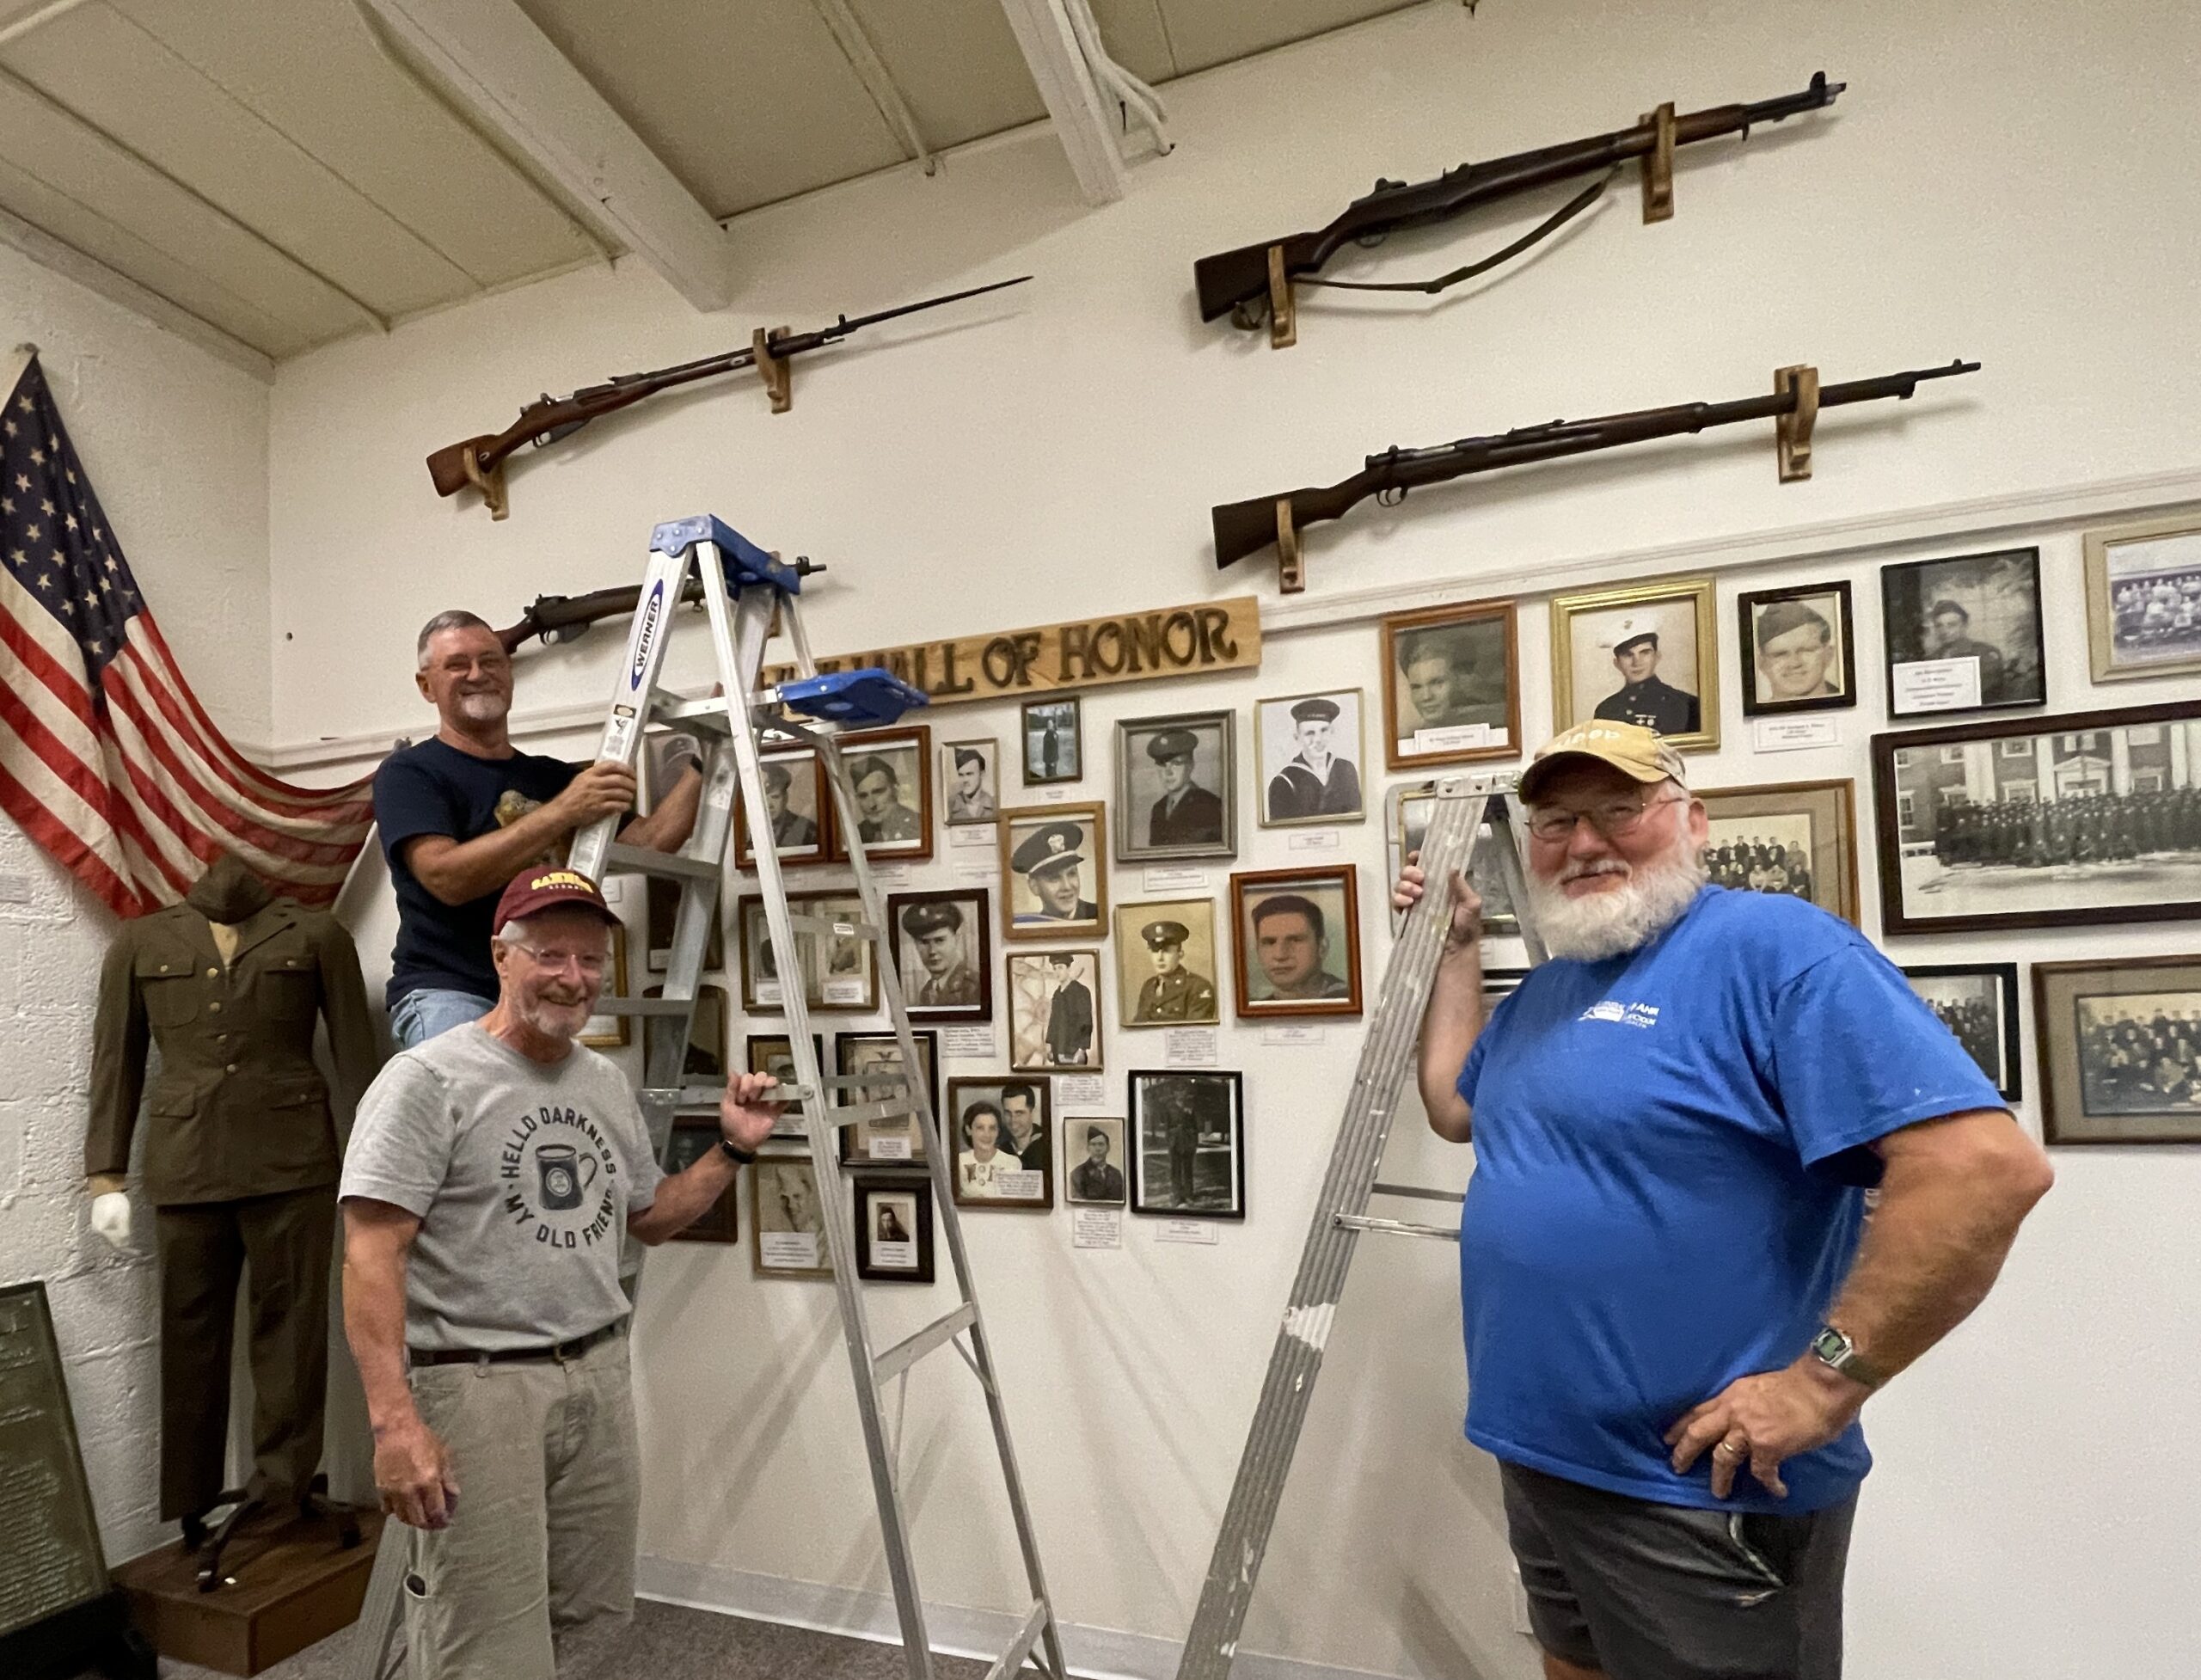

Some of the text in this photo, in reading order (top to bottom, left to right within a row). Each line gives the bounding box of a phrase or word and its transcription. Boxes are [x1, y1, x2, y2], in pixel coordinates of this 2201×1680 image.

[635, 601, 659, 668] WERNER
[981, 631, 1041, 688] OF
[1058, 607, 1238, 682] HONOR
[500, 1107, 616, 1179] HELLO DARKNESS
[505, 1193, 535, 1224] MY
[536, 1223, 577, 1248] OLD
